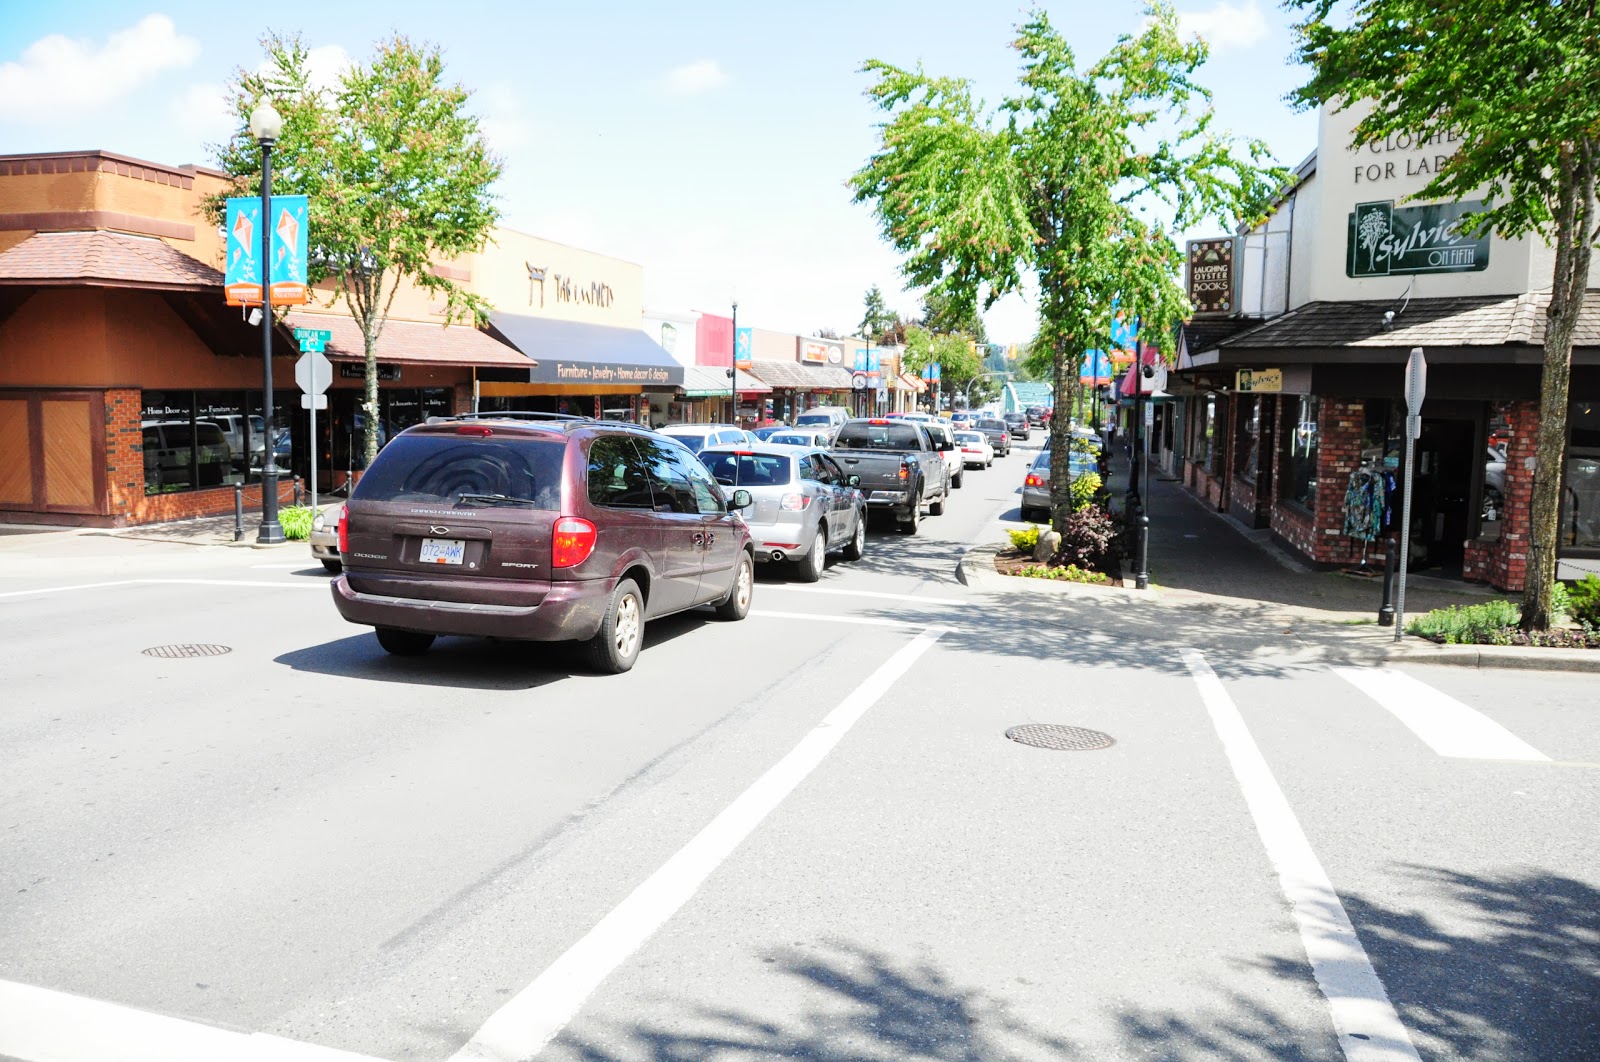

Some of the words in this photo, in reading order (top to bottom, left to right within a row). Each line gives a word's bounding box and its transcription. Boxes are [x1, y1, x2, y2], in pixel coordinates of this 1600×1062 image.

[1354, 161, 1396, 184] FOR
[1428, 250, 1449, 266] ON
[1451, 248, 1475, 265] FIFTH
[1194, 264, 1229, 274] LAUGHING
[1194, 271, 1228, 280] OYSTER
[1193, 281, 1229, 292] BOOKS
[557, 363, 588, 379] Furniture
[592, 365, 614, 381] Jewelry
[617, 366, 633, 379] Home
[633, 367, 648, 380] decor
[652, 367, 669, 383] design
[147, 406, 163, 415] Home
[165, 405, 180, 414] Decor
[208, 404, 231, 412] Furniture
[438, 508, 476, 516] CARAVAN
[353, 552, 388, 560] DODGE
[501, 561, 539, 569] SPORT
